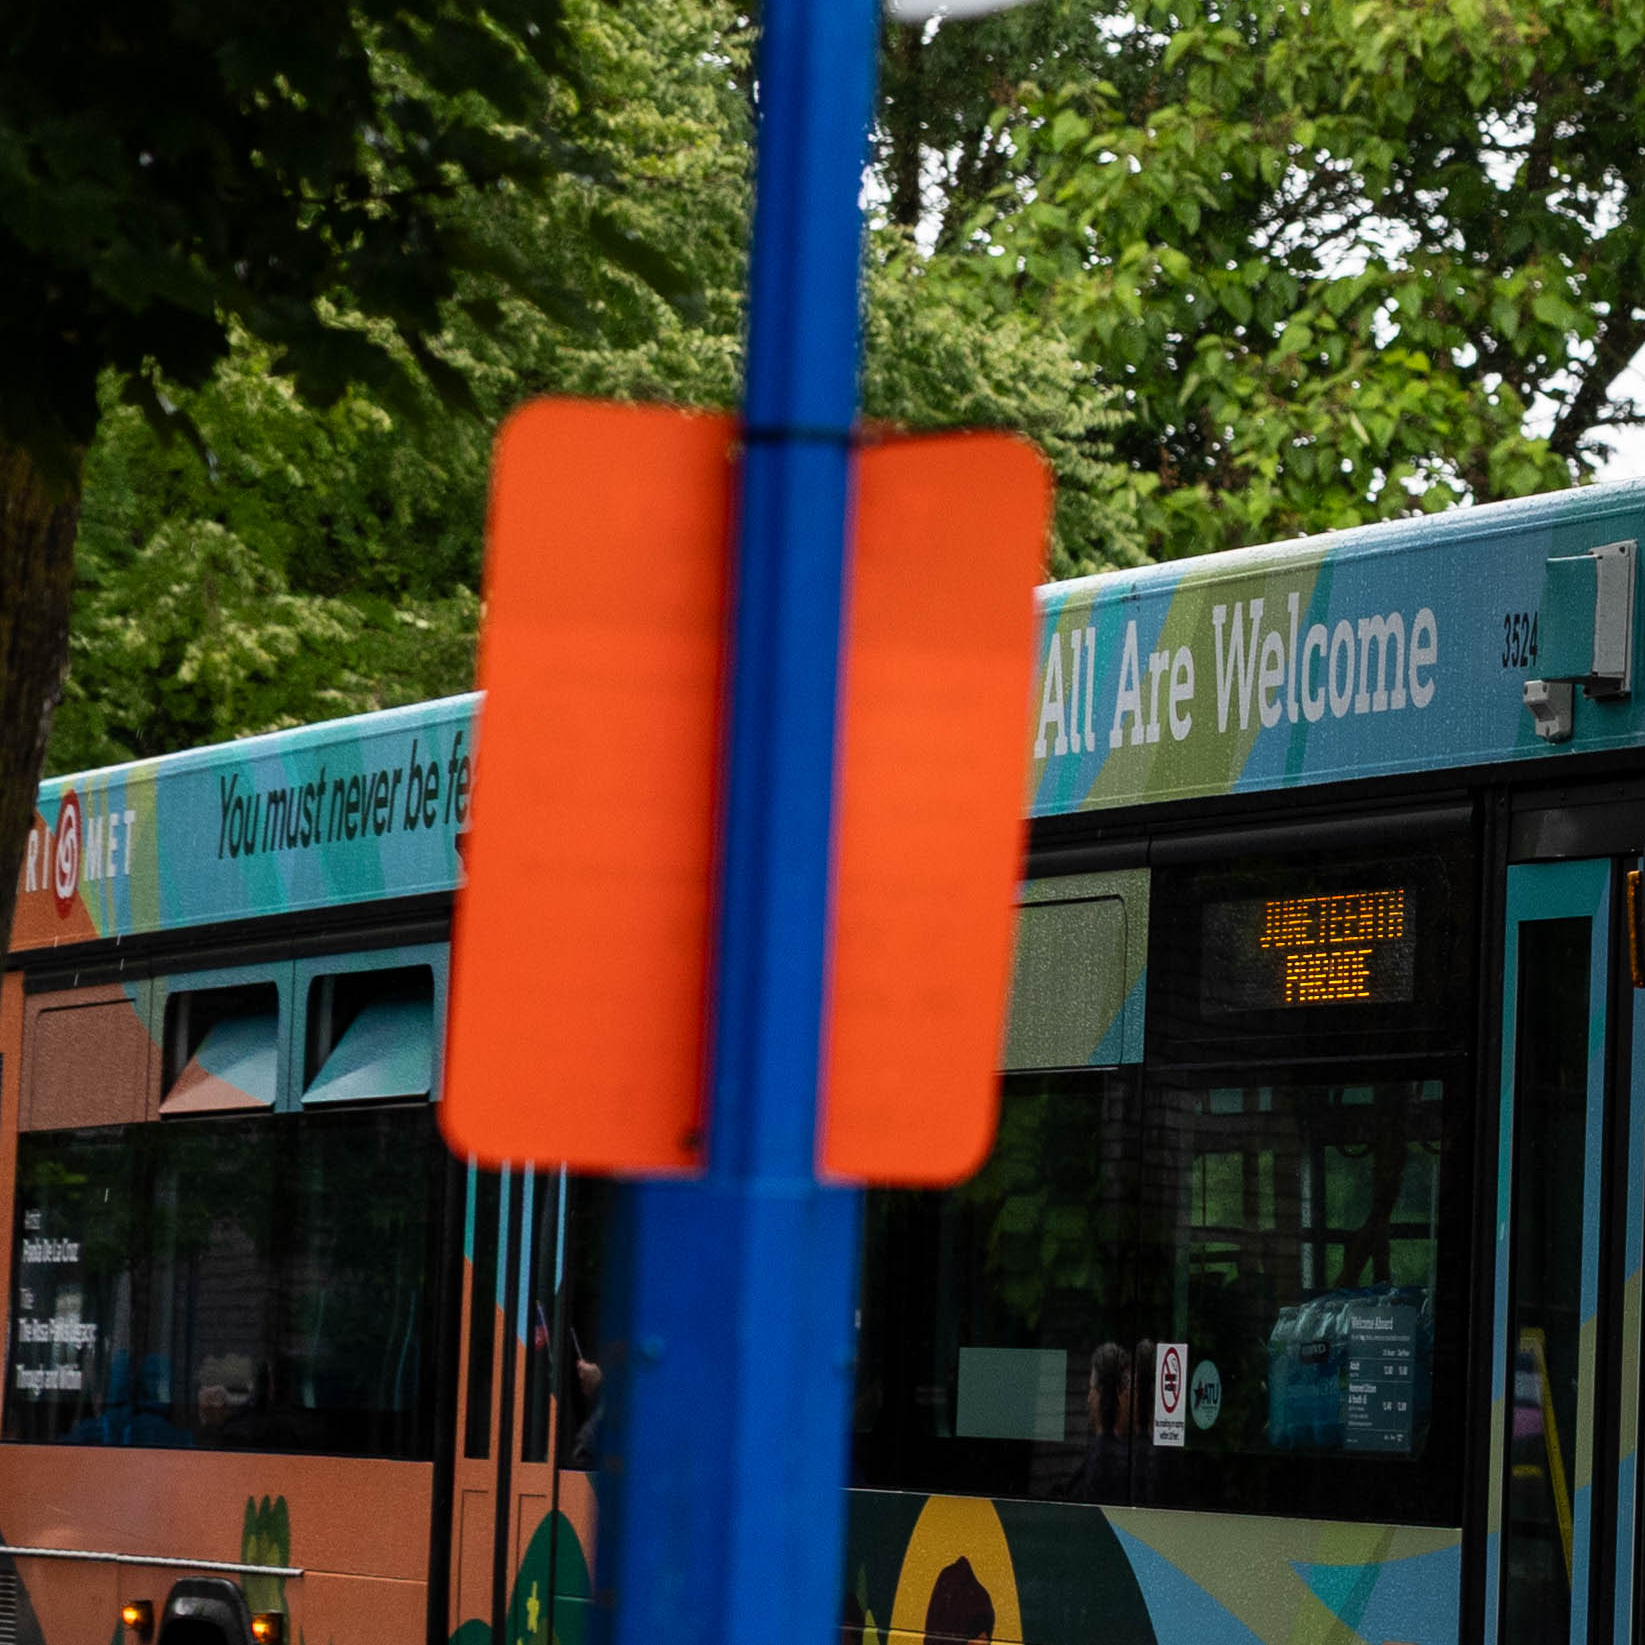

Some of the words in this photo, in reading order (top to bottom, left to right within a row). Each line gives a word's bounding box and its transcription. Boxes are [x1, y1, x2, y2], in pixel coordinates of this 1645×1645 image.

[1502, 610, 1538, 668] 3524
[1034, 626, 1097, 759] All
[1109, 619, 1195, 750] Are
[1212, 591, 1438, 733] Welcome
[218, 773, 261, 860] You
[262, 766, 326, 852] must
[328, 768, 404, 842] never
[403, 738, 440, 831] be
[445, 730, 472, 825] fe
[25, 825, 51, 893] RI
[83, 809, 137, 881] MET
[1259, 889, 1404, 949] JUNETEENTH
[1285, 948, 1373, 1002] PARADE
[1201, 1383, 1219, 1405] ATU
